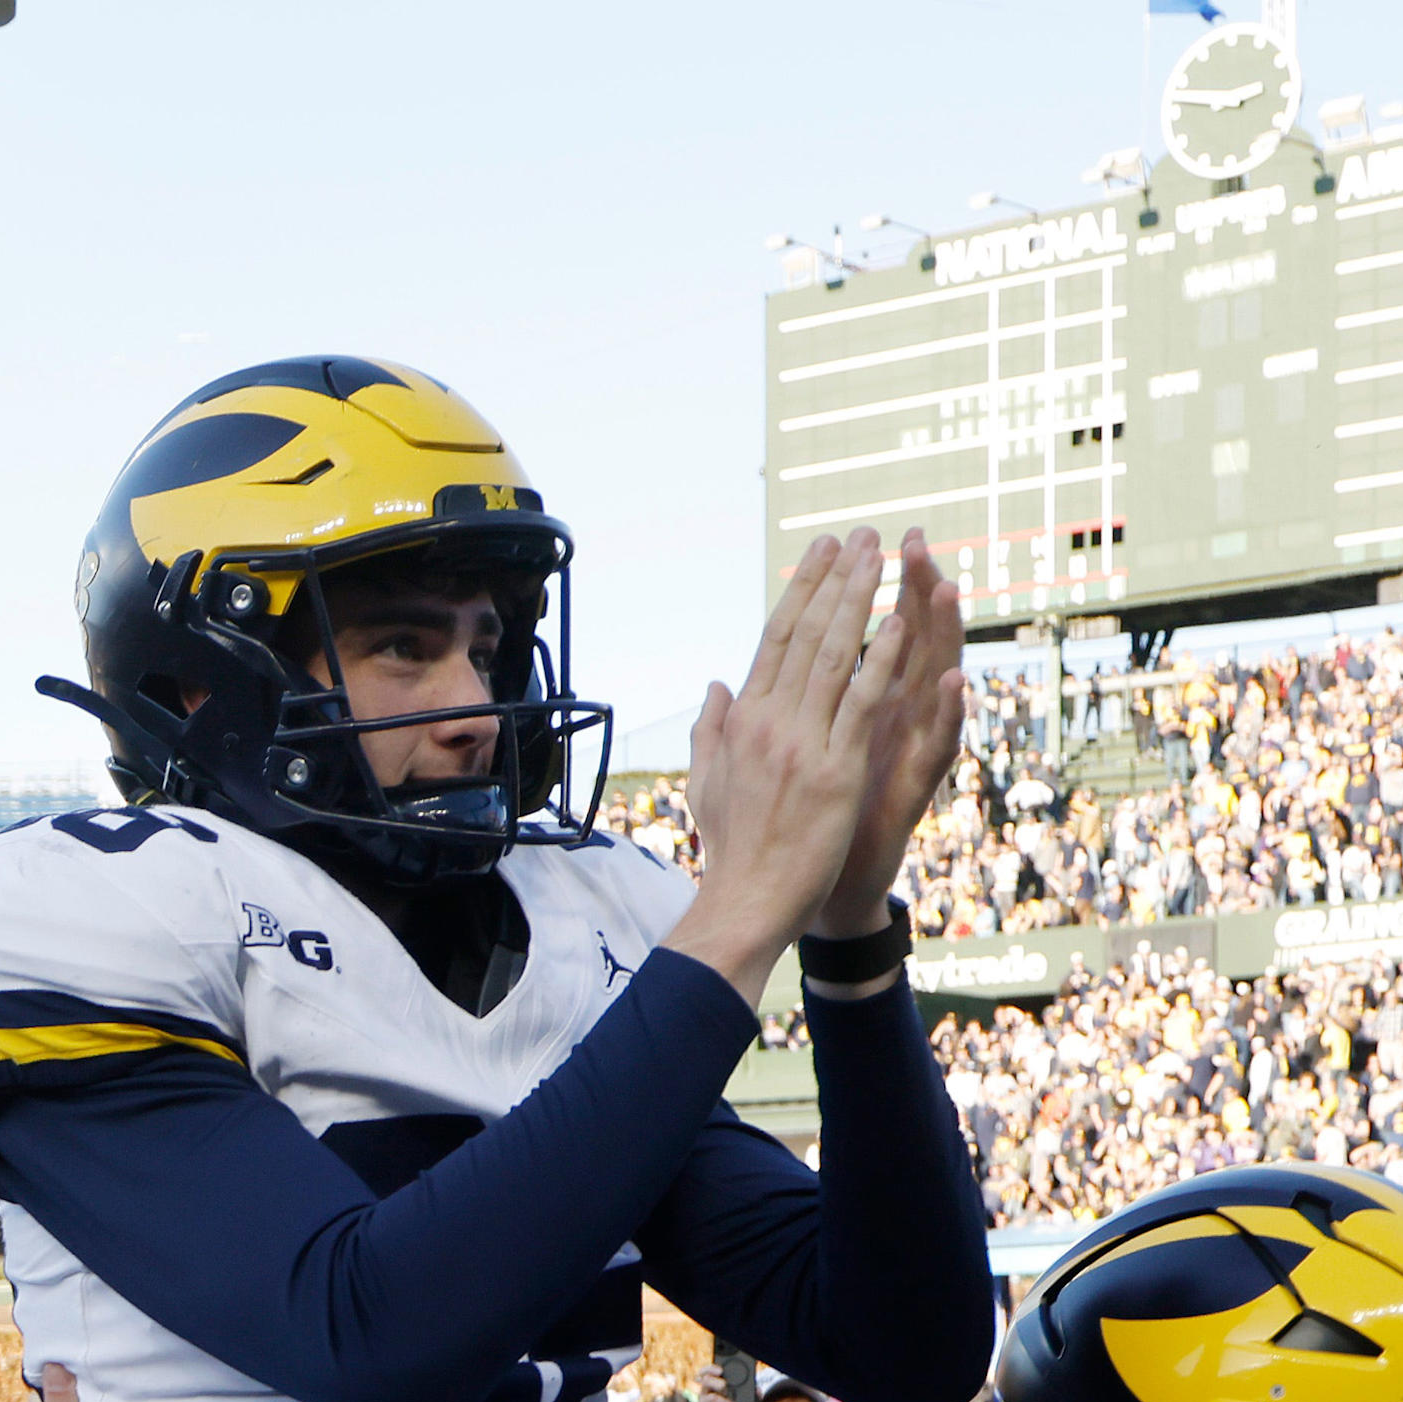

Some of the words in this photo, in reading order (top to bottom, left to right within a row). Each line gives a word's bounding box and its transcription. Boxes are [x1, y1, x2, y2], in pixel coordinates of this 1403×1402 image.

[934, 206, 1128, 287] NATIONAL
[479, 485, 519, 512] M
[905, 944, 1048, 994] tytrade
